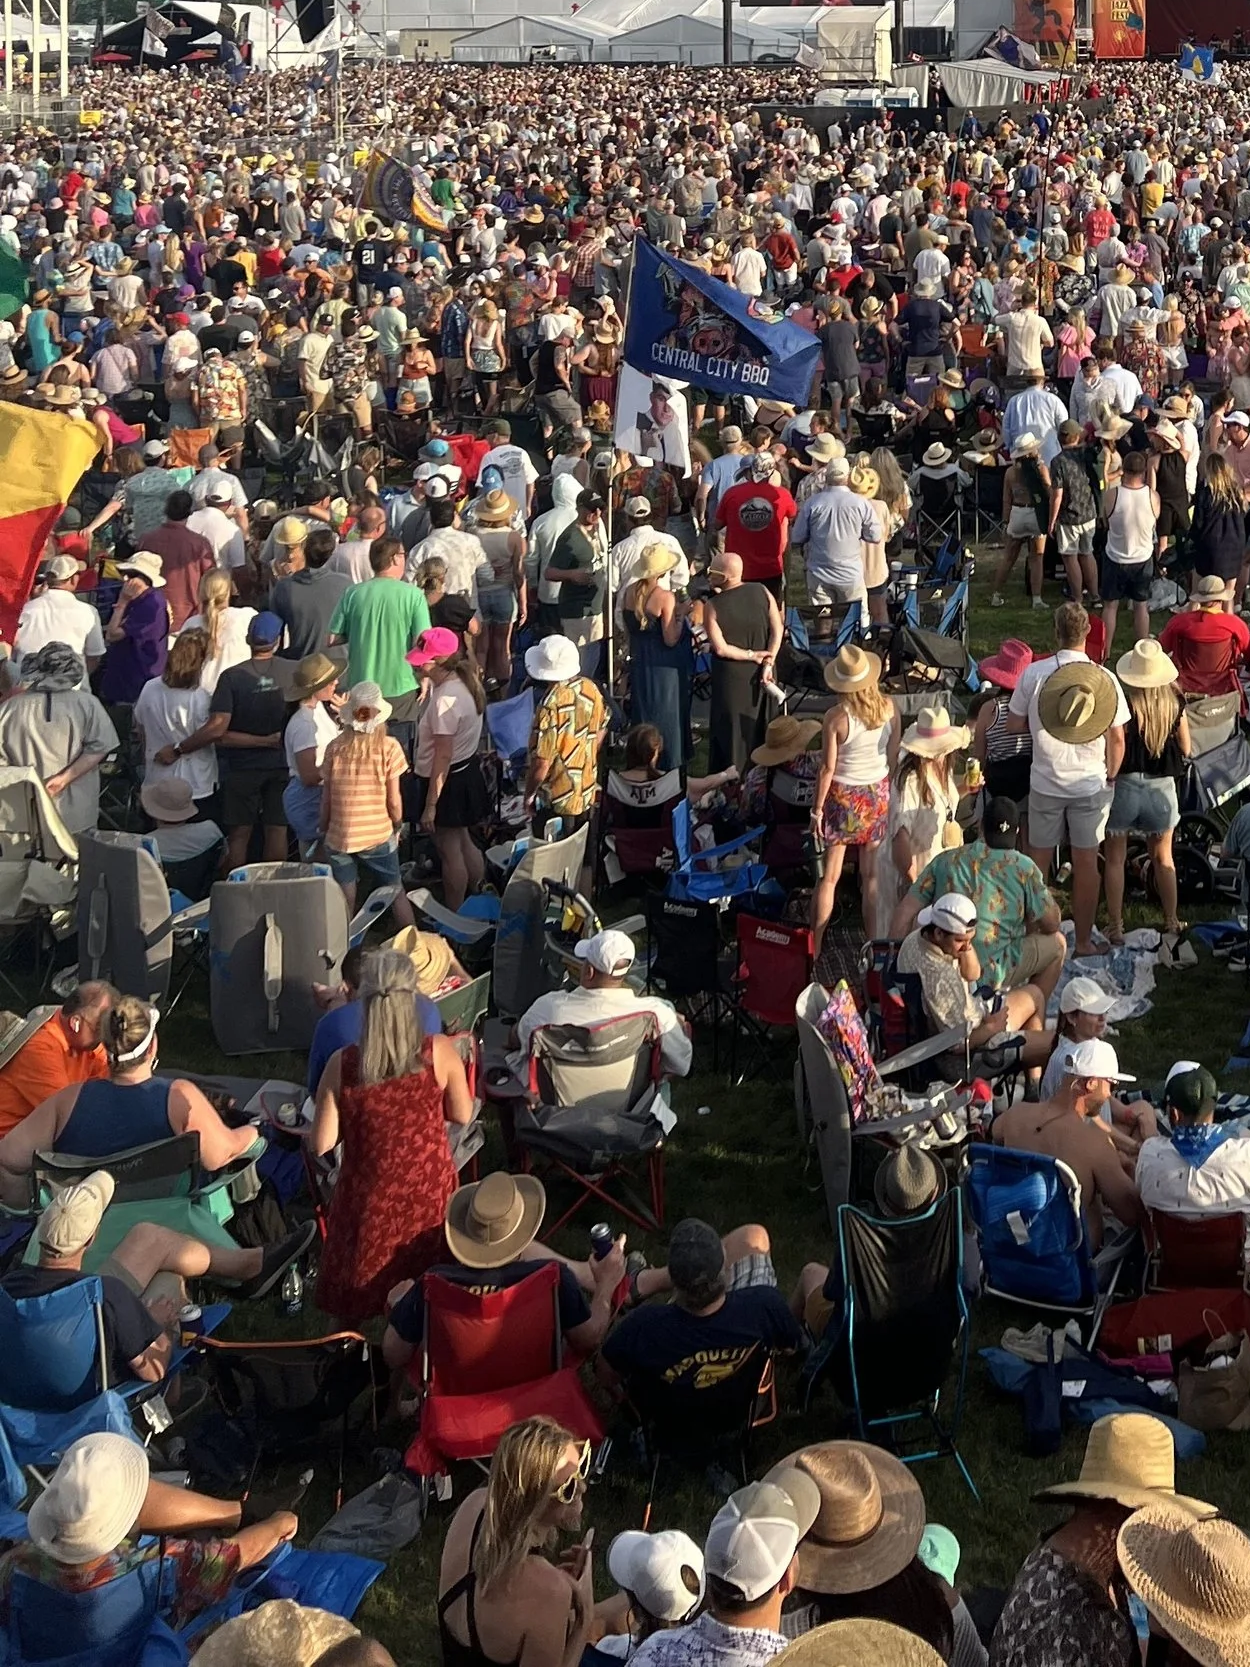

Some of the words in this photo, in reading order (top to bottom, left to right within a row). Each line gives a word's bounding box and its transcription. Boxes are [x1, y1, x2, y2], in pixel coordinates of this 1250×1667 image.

[362, 249, 375, 265] 21
[651, 342, 703, 373] CENTRAL
[706, 356, 740, 380] CITY
[741, 363, 770, 386] BBQ
[756, 926, 791, 941] Academy
